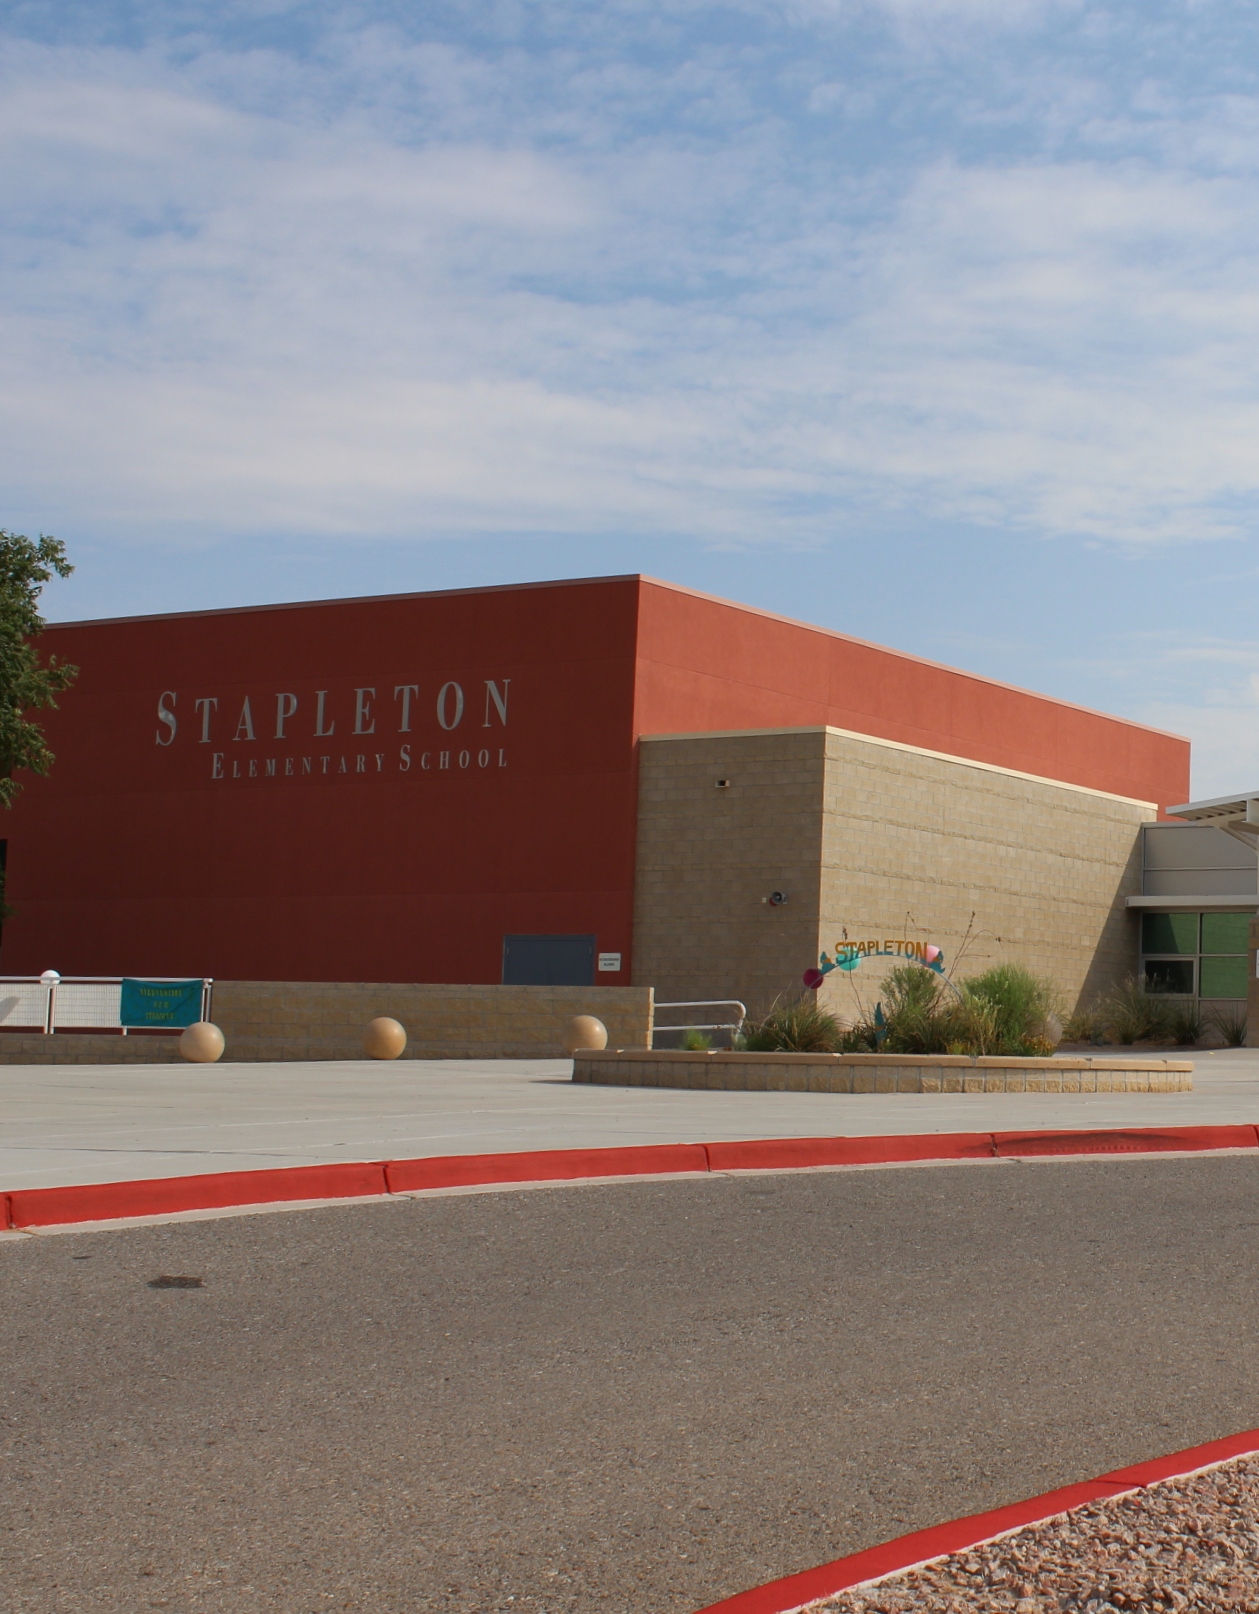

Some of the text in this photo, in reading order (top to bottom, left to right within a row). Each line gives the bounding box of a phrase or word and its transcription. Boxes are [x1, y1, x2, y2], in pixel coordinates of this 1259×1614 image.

[155, 678, 512, 746] STAPLETON
[210, 744, 507, 779] ELEMENTARY SCHOOL
[835, 939, 928, 965] STAPLETON
